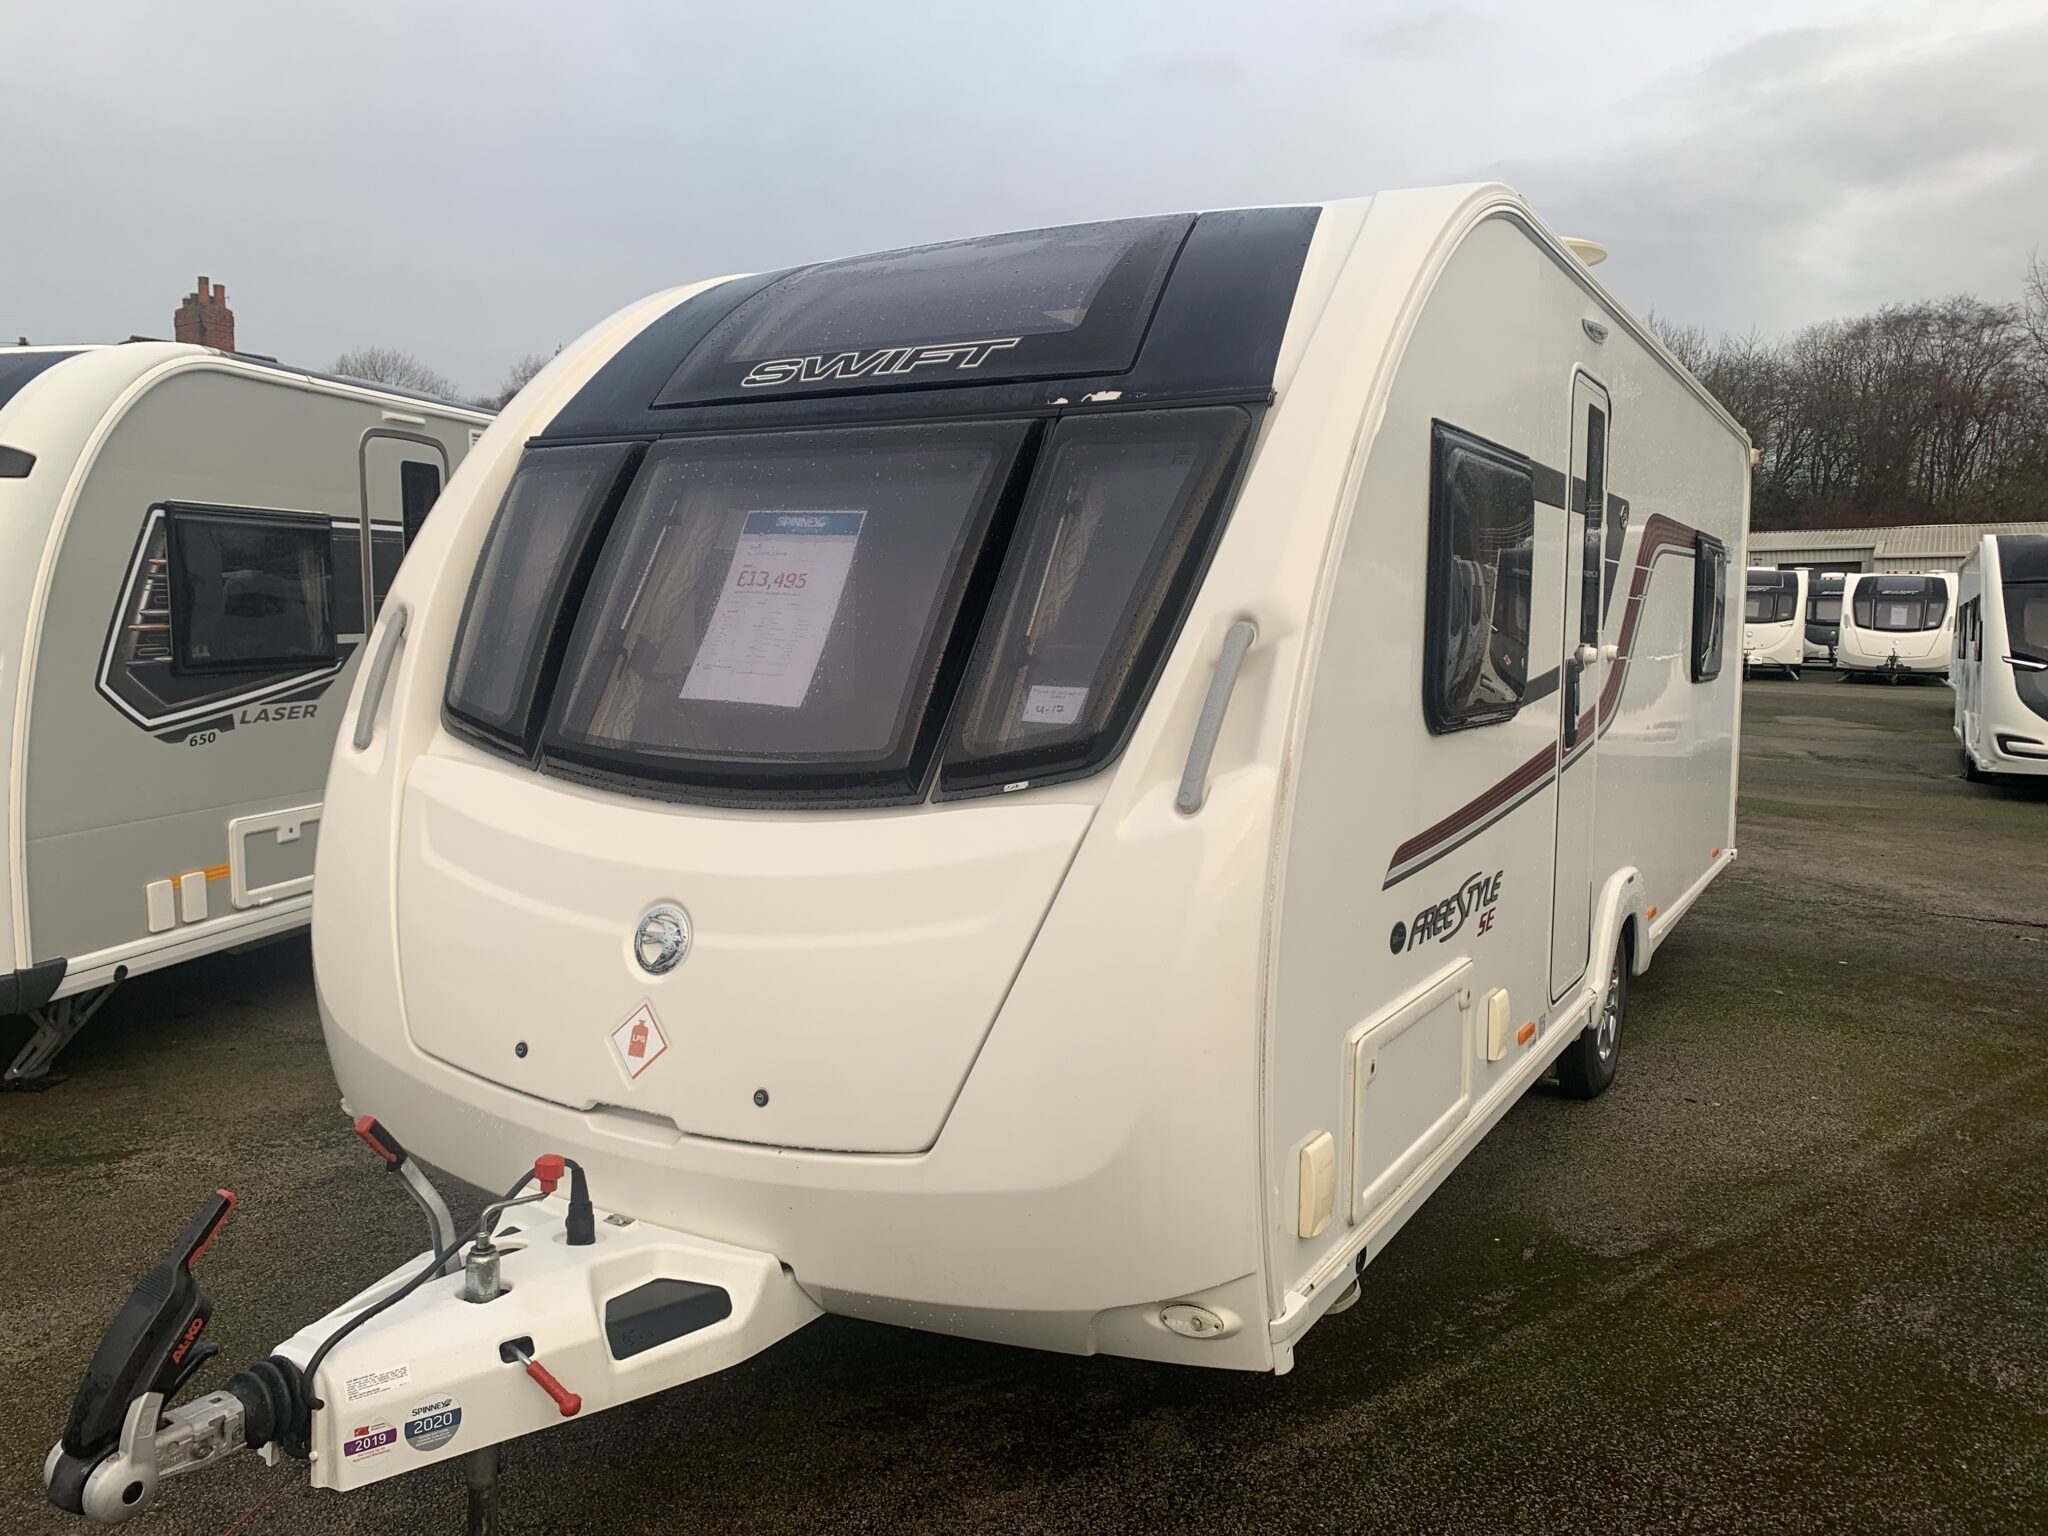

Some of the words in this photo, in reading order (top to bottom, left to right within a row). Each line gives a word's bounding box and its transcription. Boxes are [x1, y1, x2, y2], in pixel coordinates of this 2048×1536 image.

[740, 336, 1024, 388] SWIFT
[776, 516, 826, 528] SPINNEY
[736, 570, 809, 590] £13,495
[239, 703, 318, 725] LASER
[189, 731, 216, 748] 650
[1477, 907, 1496, 937] SE
[632, 1034, 646, 1043] LPG
[411, 1400, 449, 1416] SPINNEY
[414, 1412, 452, 1434] 2020
[355, 1433, 387, 1452] 2019
